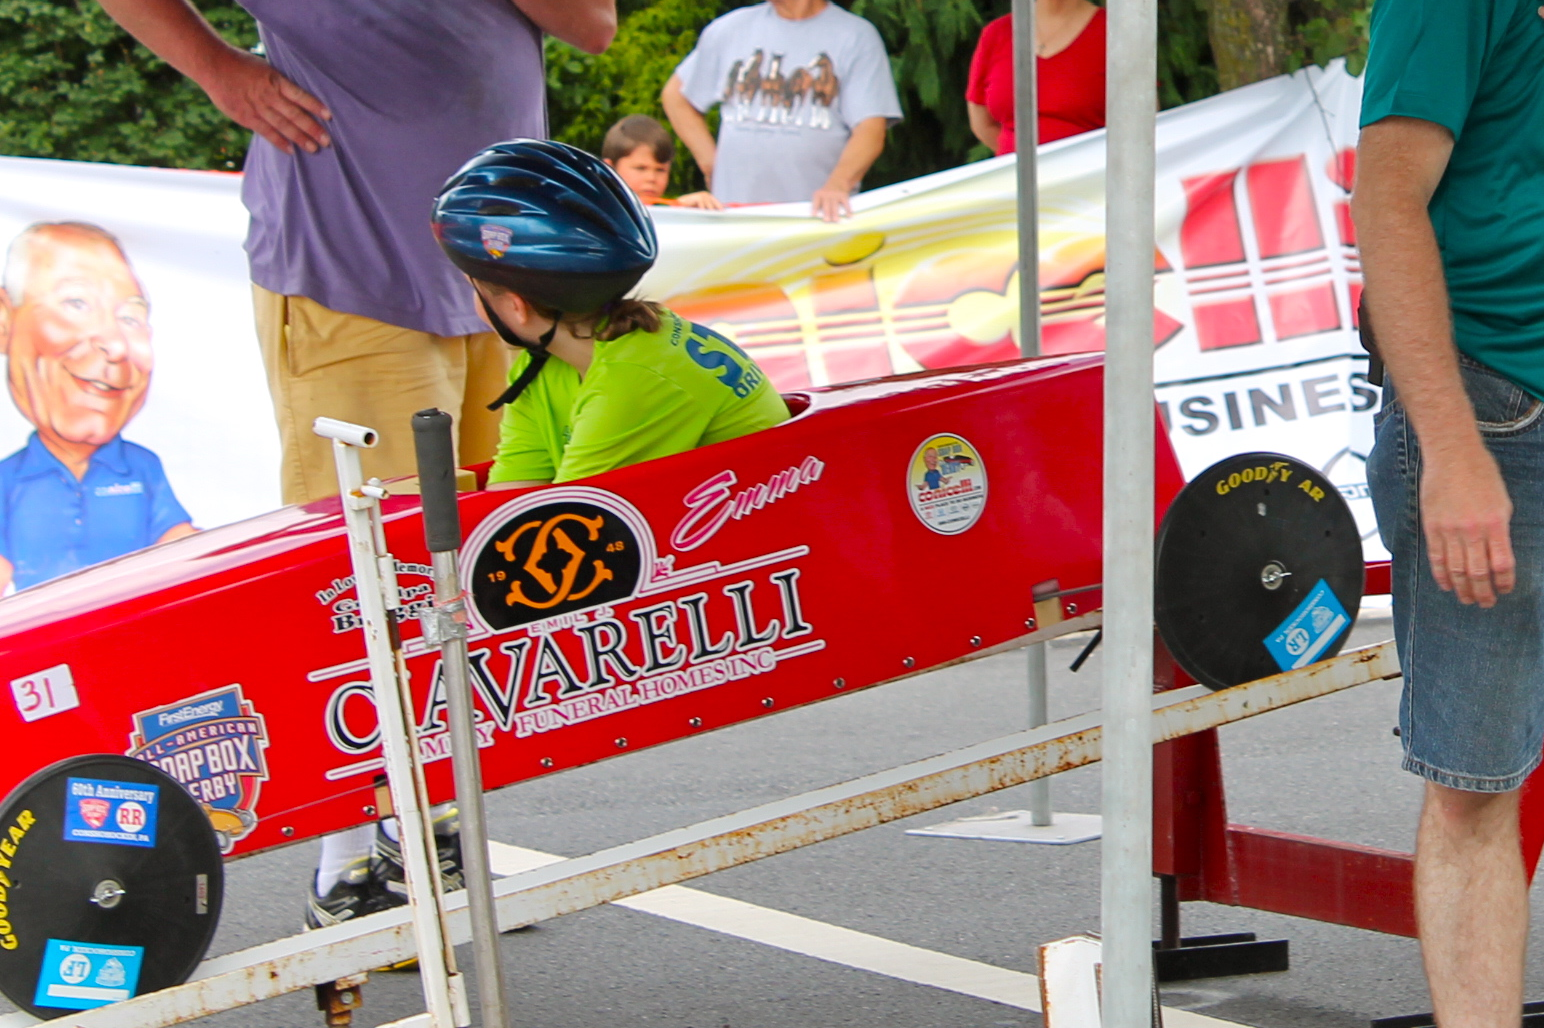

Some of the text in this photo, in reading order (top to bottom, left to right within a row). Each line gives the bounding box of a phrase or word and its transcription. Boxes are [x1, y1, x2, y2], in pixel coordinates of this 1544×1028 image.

[671, 456, 824, 551] Emma
[605, 540, 625, 553] 48
[487, 570, 507, 583] 19
[530, 613, 585, 633] EMIL
[328, 571, 810, 751] CAVARELLI
[20, 677, 55, 712] 31
[517, 649, 774, 736] FUNERAL HOMES INC
[158, 700, 223, 727] FirstEnergy
[205, 735, 258, 774] BOX
[95, 784, 155, 804] Anniversary
[188, 771, 236, 803] ERBY
[119, 808, 143, 826] RR
